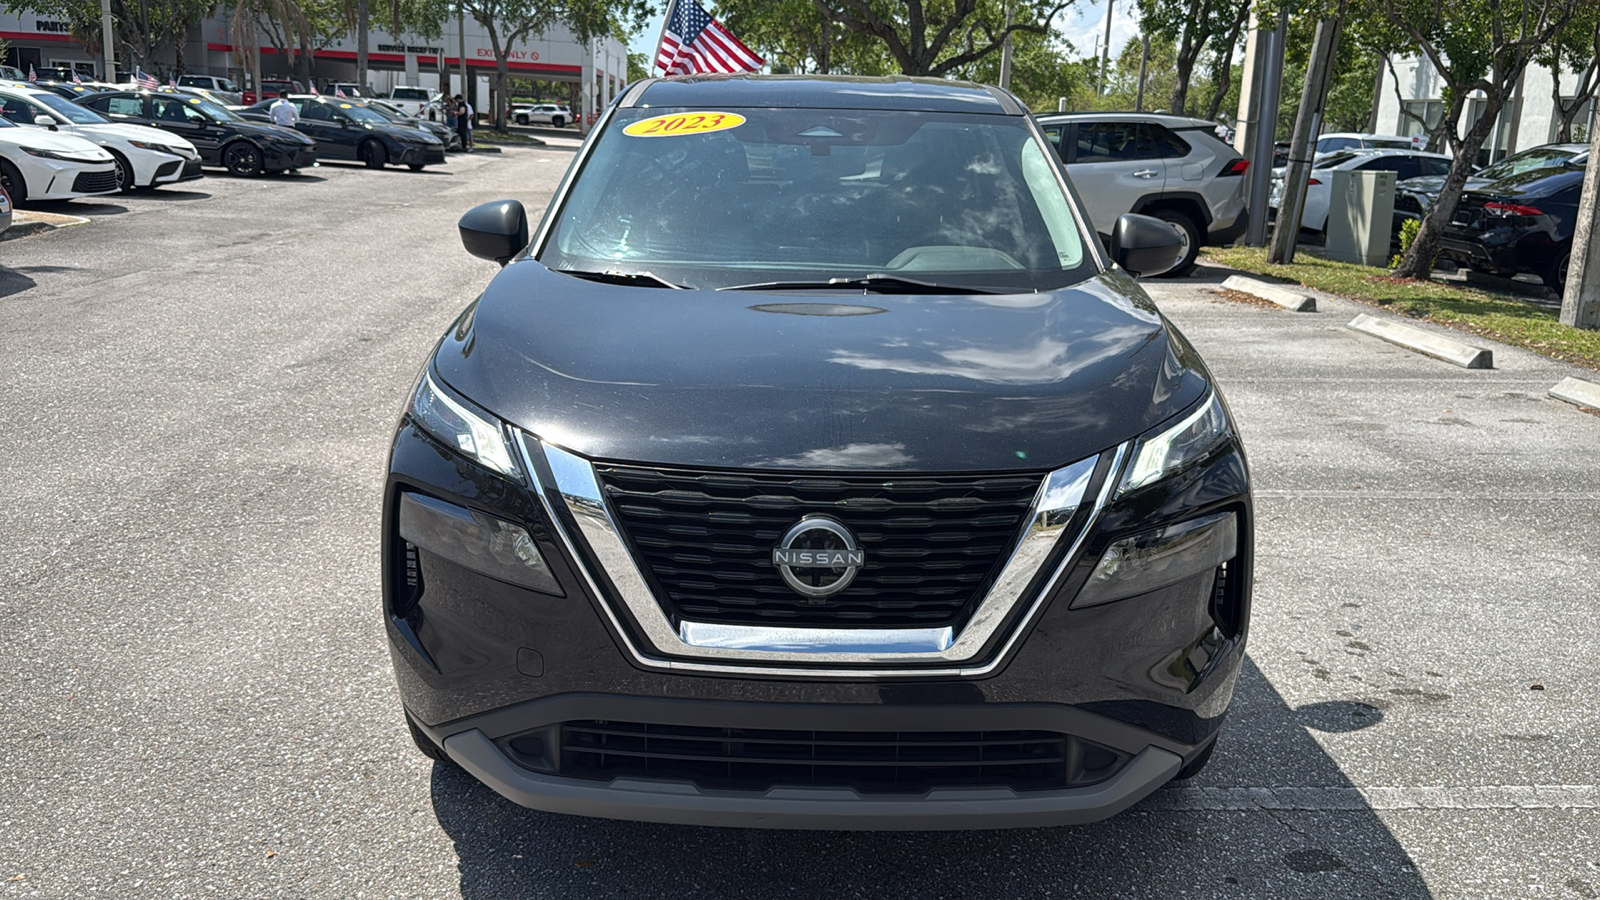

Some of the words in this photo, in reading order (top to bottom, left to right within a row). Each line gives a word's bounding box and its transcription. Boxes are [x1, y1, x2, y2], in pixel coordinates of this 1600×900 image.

[377, 44, 405, 53] SERVICE
[477, 48, 494, 58] EXI
[642, 114, 726, 134] 2023
[775, 551, 861, 564] NISSAN
